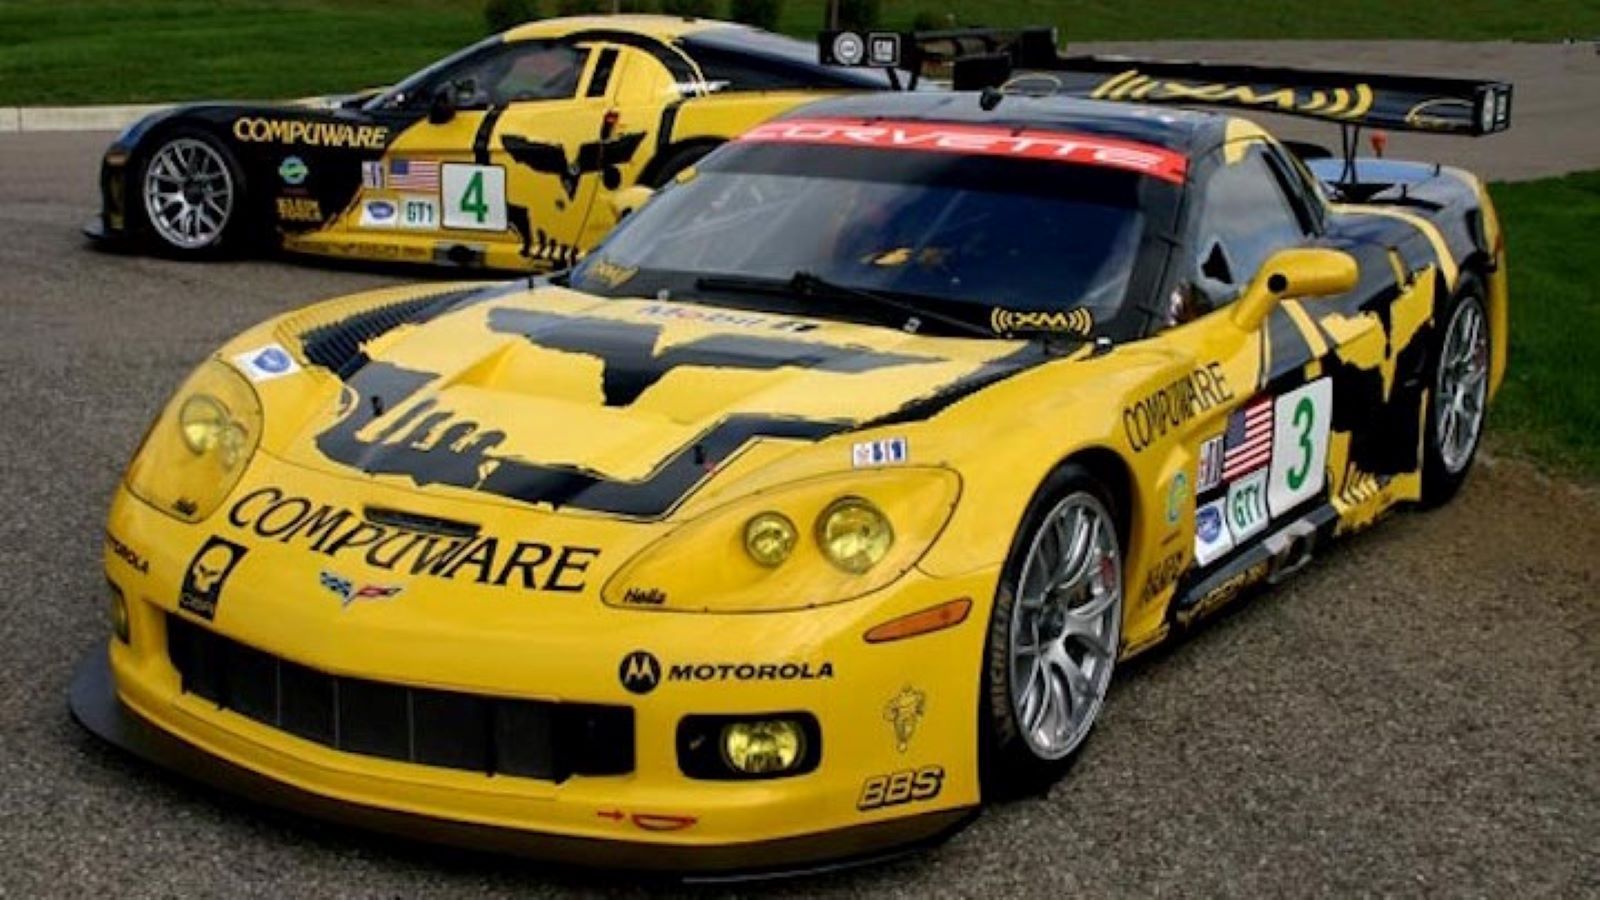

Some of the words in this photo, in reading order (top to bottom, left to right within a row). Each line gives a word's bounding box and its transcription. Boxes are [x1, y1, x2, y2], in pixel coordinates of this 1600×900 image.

[233, 117, 388, 149] COMPUWARE
[741, 120, 1166, 170] CORVETTE
[406, 201, 434, 223] GT1
[459, 170, 489, 224] 4
[1122, 361, 1234, 453] COMPUWARE
[1286, 396, 1315, 491] 3
[228, 487, 601, 593] COMPUWARE
[668, 662, 834, 681] MOTOROLA
[856, 767, 945, 811] BBS
